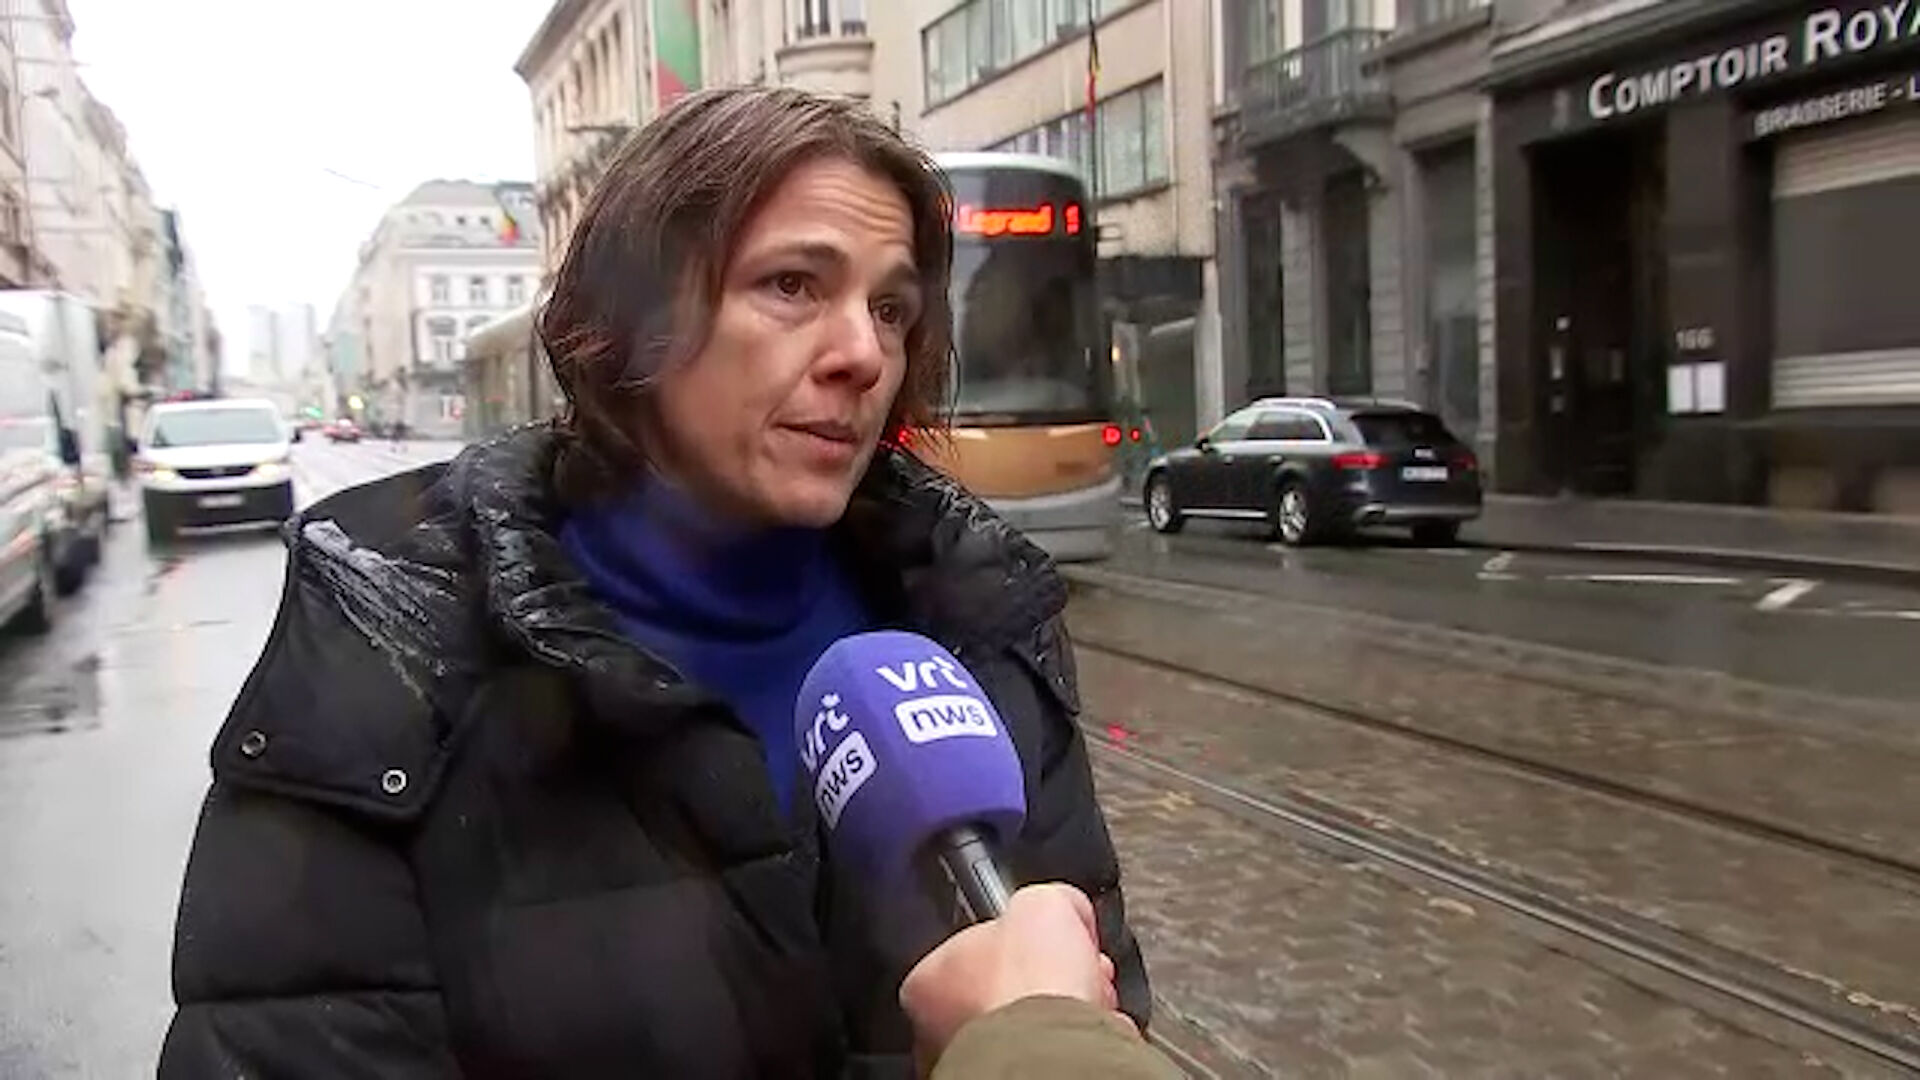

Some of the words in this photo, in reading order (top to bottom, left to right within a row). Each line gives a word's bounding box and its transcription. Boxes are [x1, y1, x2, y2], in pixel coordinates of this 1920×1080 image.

[1588, 35, 1789, 119] COMPTOIR
[1754, 82, 1888, 137] BRASSERIE
[959, 204, 1052, 236] Legrand
[876, 656, 968, 692] vrt
[910, 704, 985, 732] nws
[819, 749, 864, 818] nws
